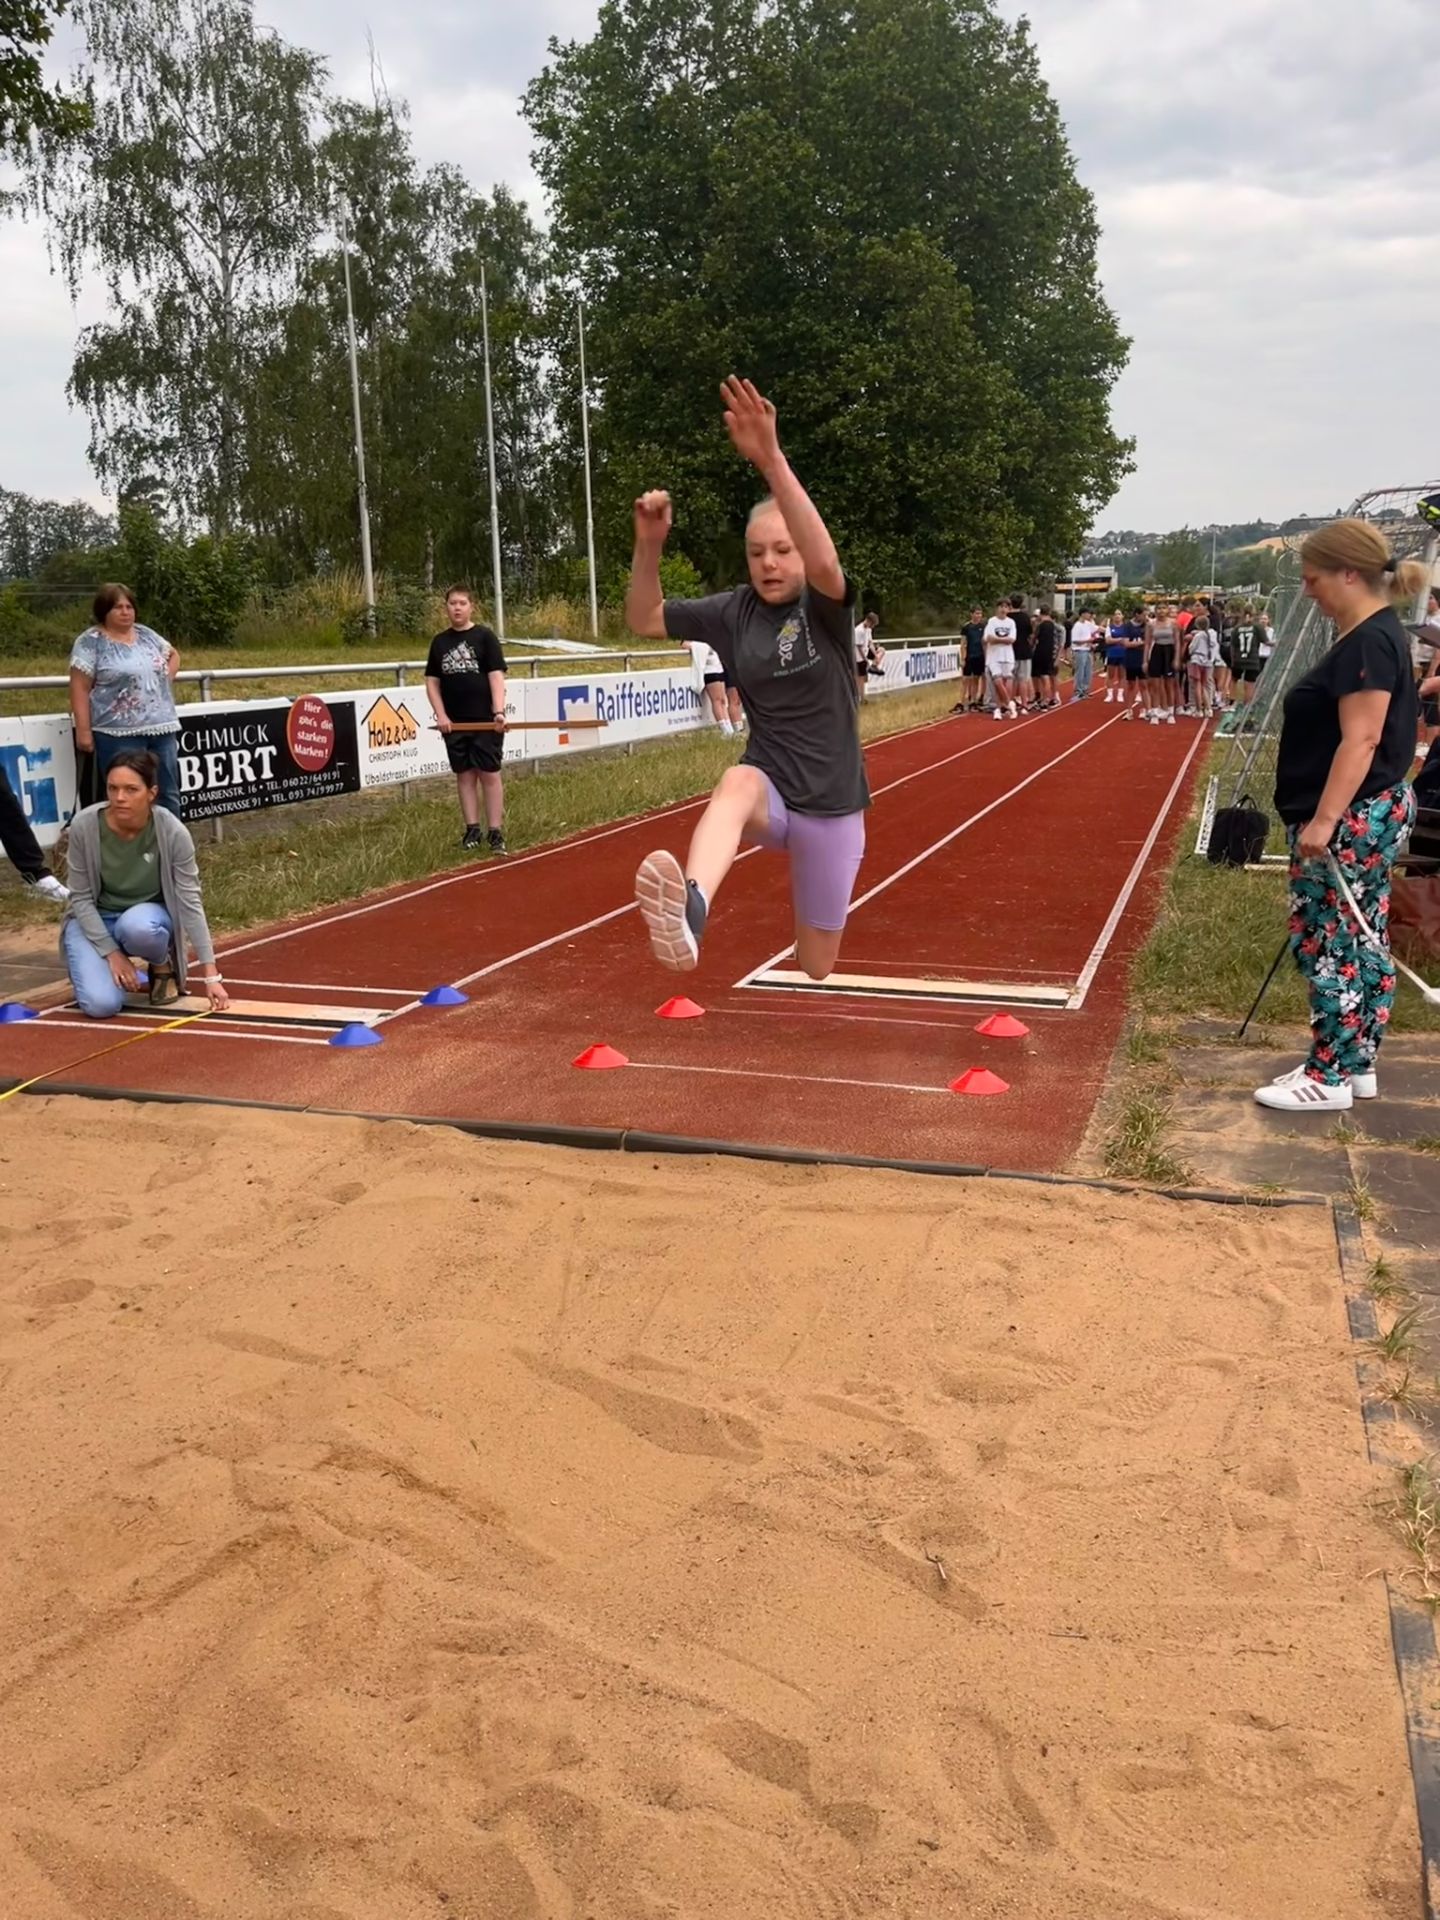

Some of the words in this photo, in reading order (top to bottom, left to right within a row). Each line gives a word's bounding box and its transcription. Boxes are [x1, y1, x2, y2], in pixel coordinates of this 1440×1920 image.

[304, 701, 321, 713] Hier
[320, 719, 334, 730] die
[297, 730, 327, 744] starken
[367, 720, 392, 749] Holz
[394, 725, 401, 746] &
[368, 750, 402, 763] CHRISTOPH
[403, 747, 418, 758] KLUG
[177, 745, 278, 792] BERT
[247, 784, 258, 794] 16
[251, 797, 262, 808] 91
